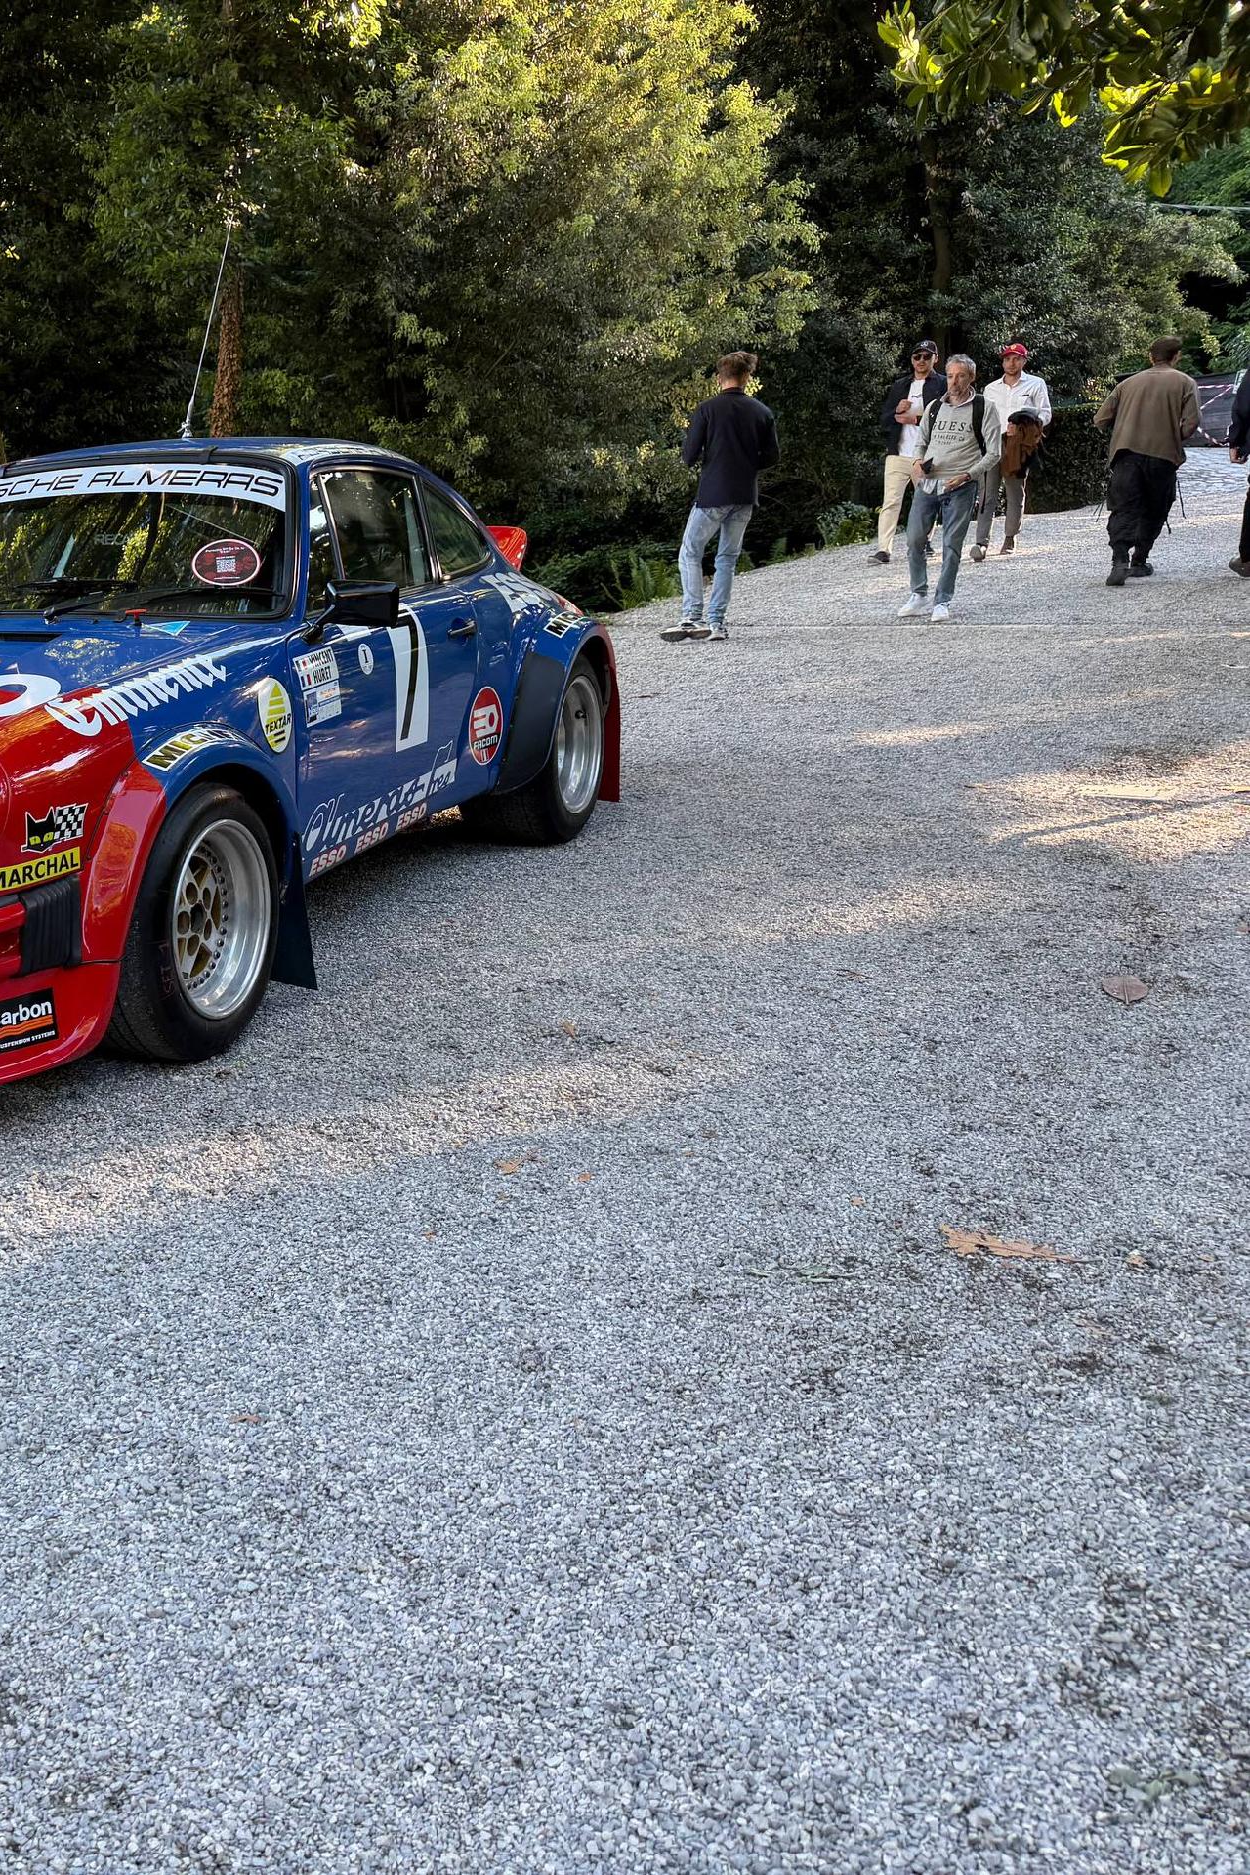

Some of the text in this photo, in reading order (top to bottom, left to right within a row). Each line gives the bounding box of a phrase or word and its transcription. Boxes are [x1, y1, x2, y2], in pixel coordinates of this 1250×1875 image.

[87, 469, 283, 497] ALMERAS
[395, 608, 419, 741] 7
[265, 713, 291, 735] TEXTAR
[473, 734, 498, 750] FACOM
[309, 802, 427, 877] ESSO ESSO ESSO
